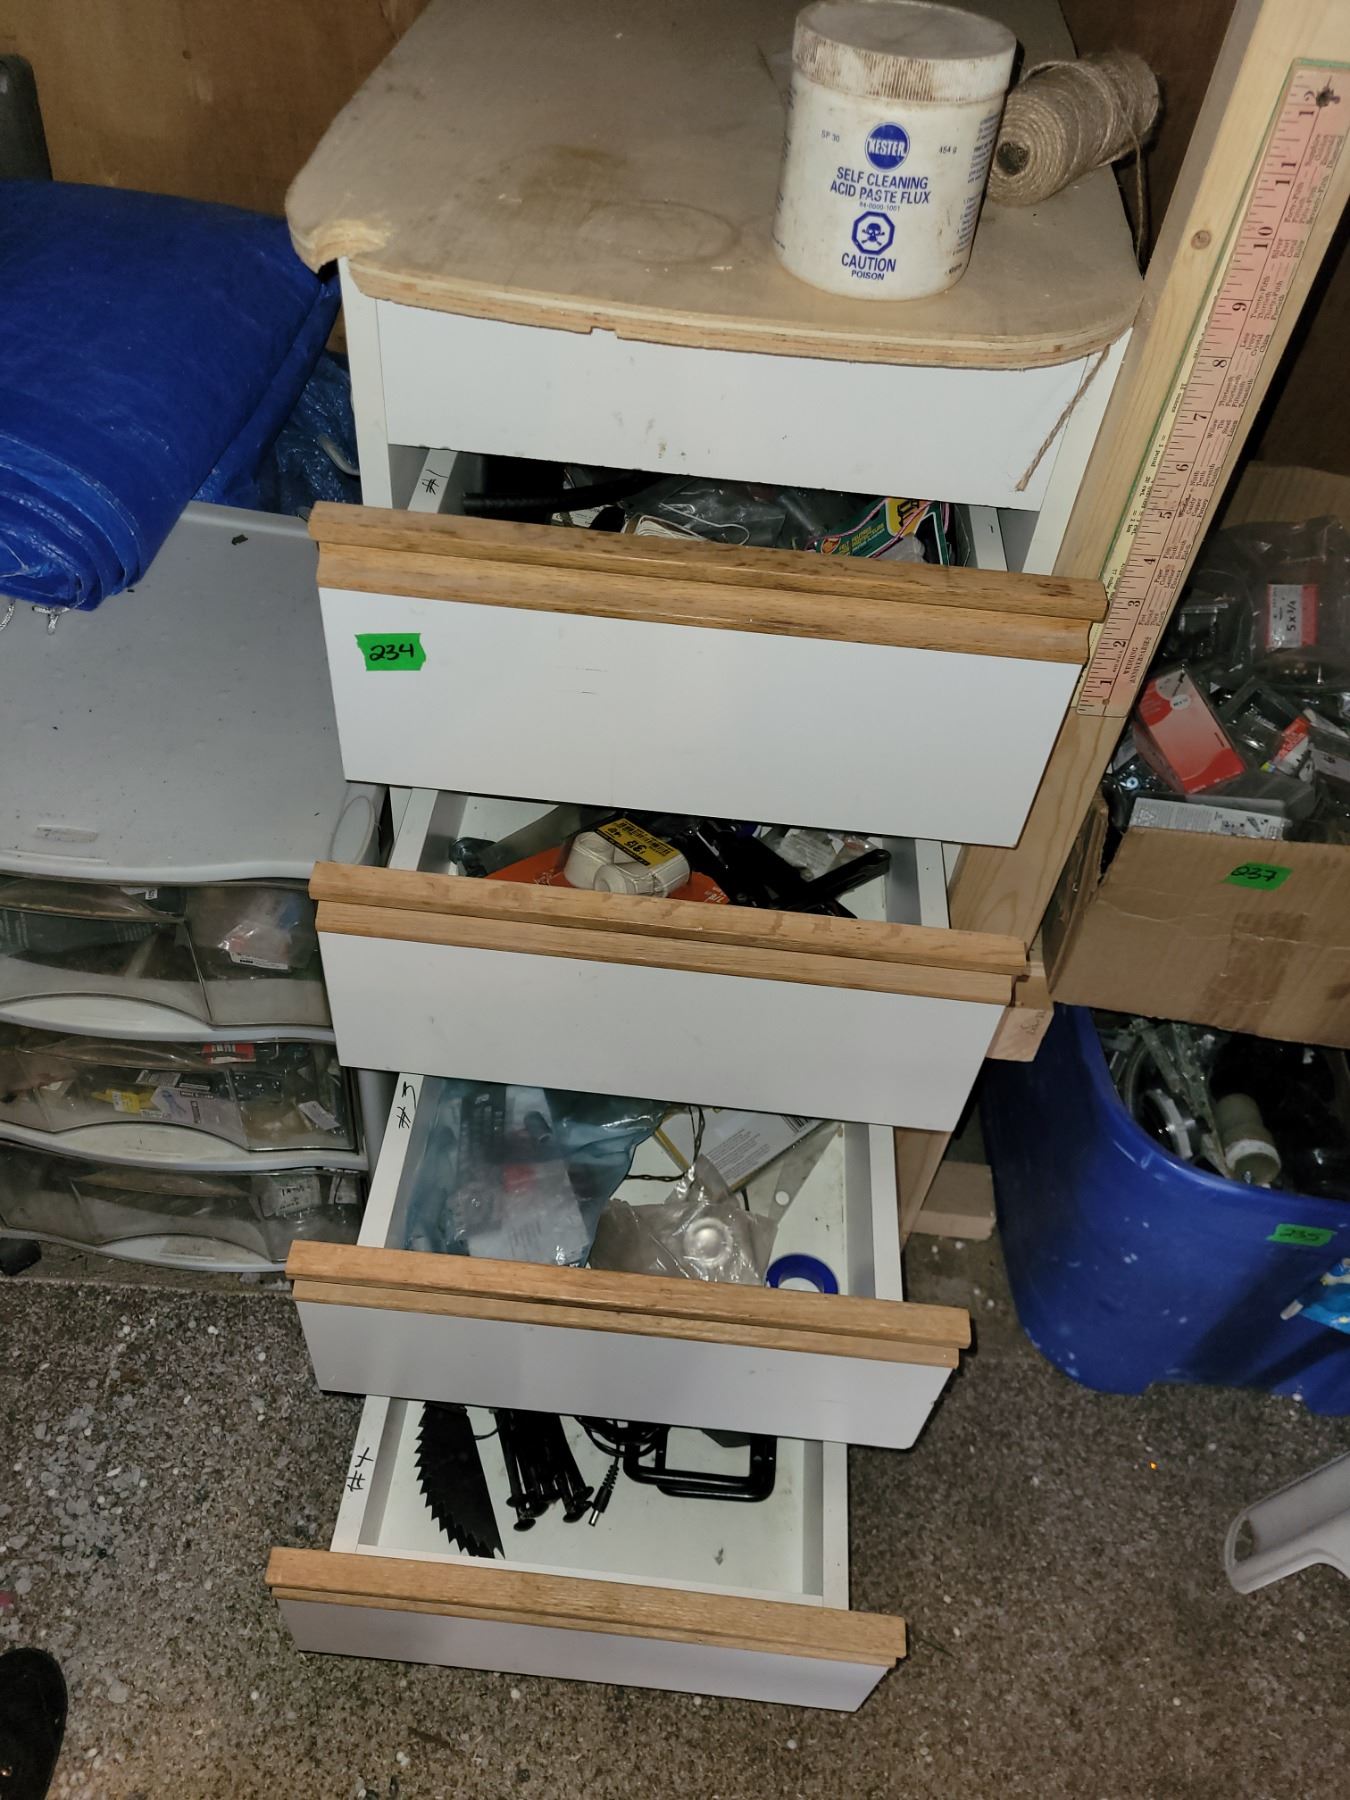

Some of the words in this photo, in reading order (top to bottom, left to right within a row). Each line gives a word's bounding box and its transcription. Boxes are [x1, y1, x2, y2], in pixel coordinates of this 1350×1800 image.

[836, 166, 864, 184] SELF
[867, 173, 929, 190] CLEANING
[830, 180, 856, 198] ACID
[859, 186, 897, 204] PASTE
[900, 191, 932, 204] FLUX
[841, 252, 897, 273] CAUTION
[851, 269, 885, 281] POISON
[1231, 301, 1247, 311] 9
[1212, 358, 1227, 367] 8
[1193, 413, 1206, 421] 7
[369, 643, 414, 661] 234
[1123, 647, 1138, 673] WEDDING
